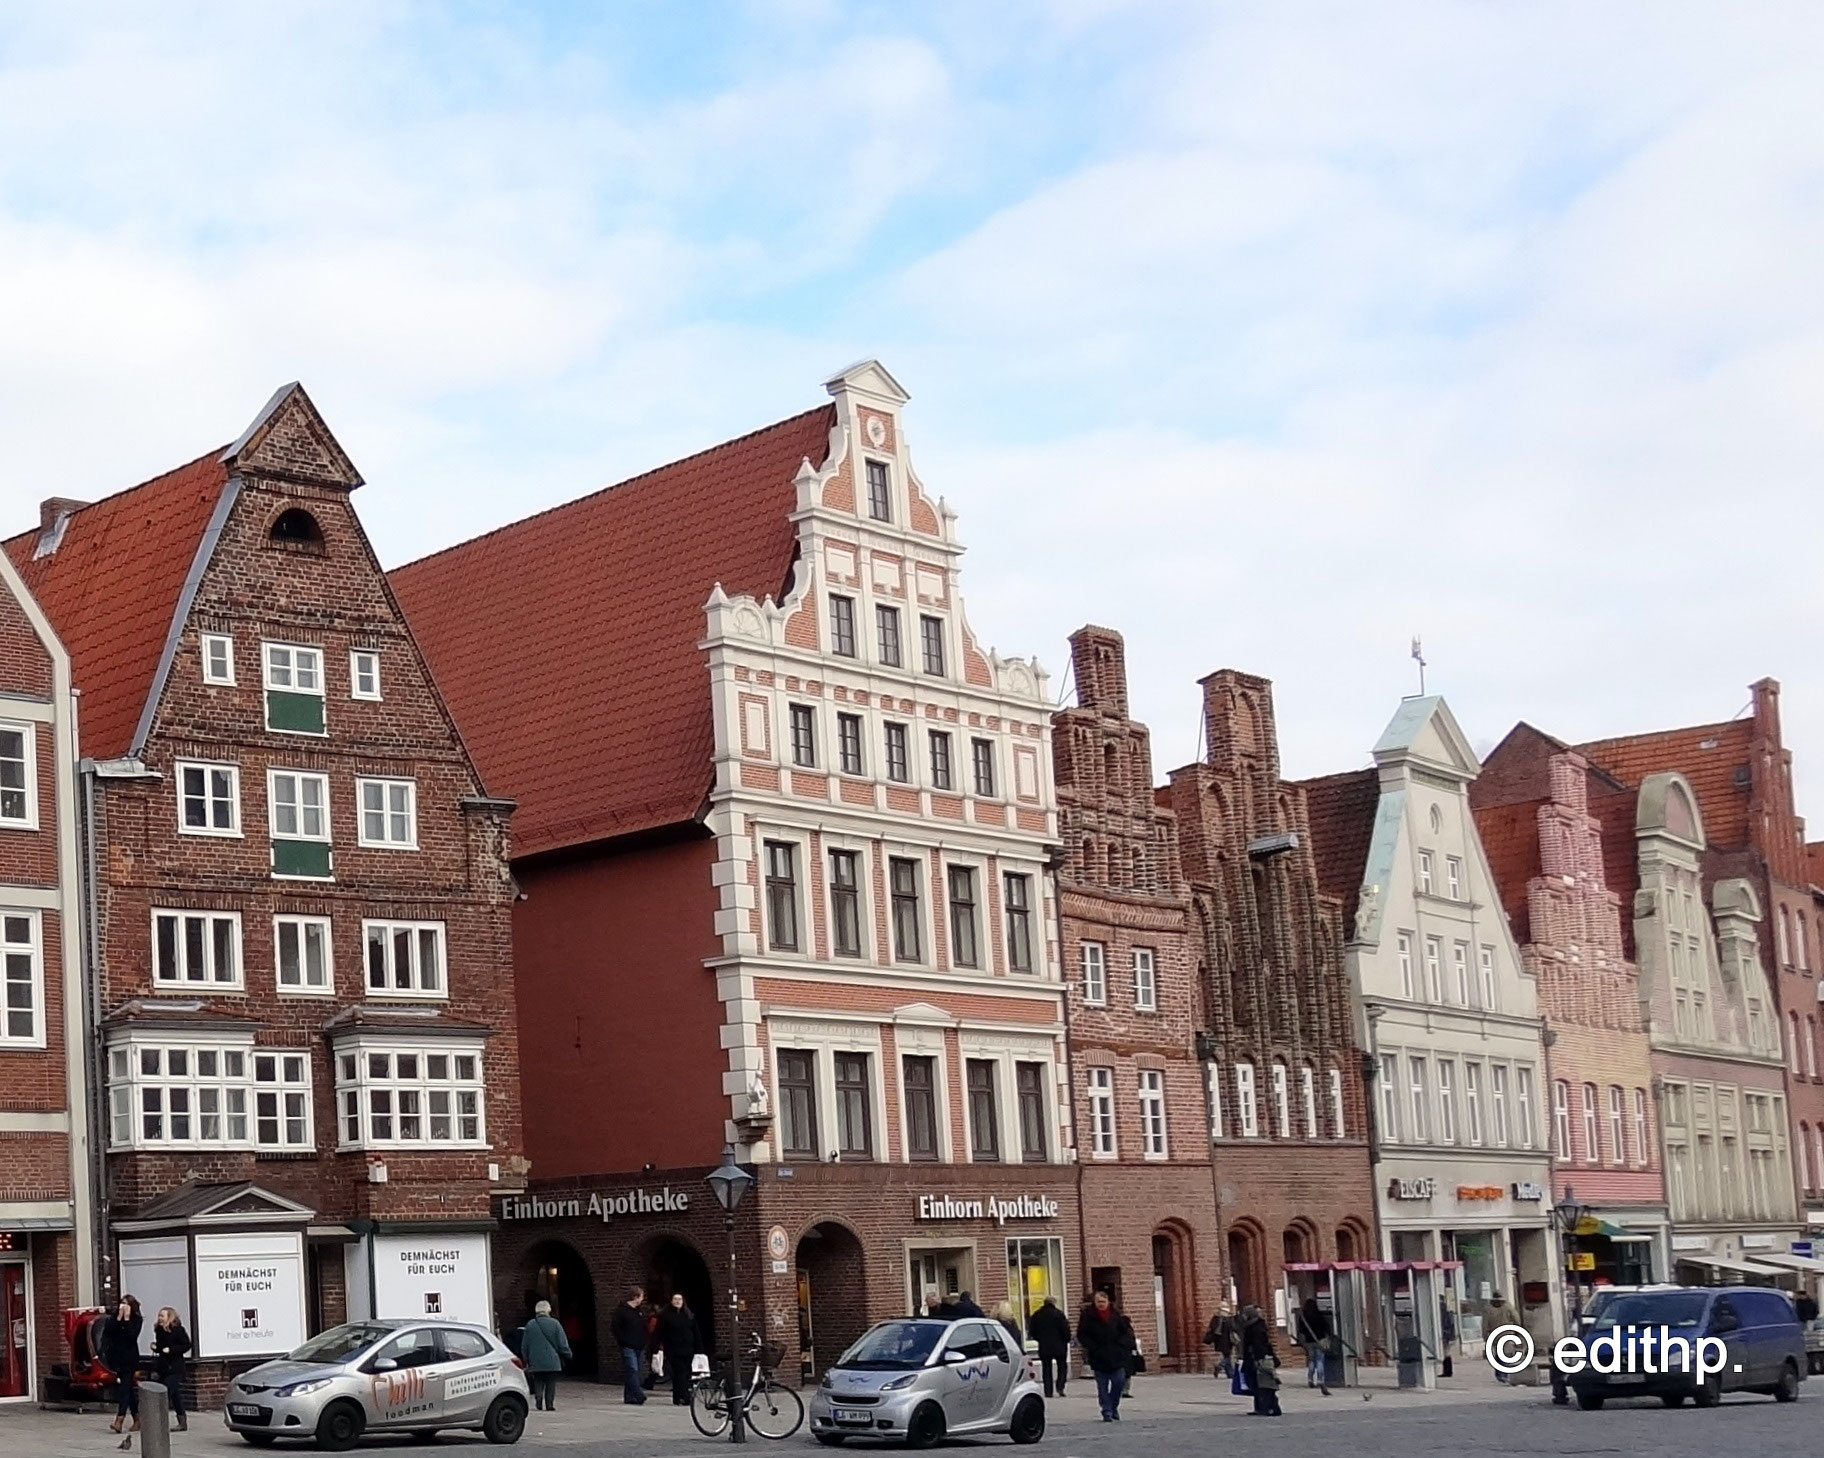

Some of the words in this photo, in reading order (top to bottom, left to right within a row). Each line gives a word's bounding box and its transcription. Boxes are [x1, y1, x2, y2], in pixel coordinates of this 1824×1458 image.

[502, 1195, 580, 1220] Einhorn
[587, 1187, 689, 1222] Apotheke
[919, 1194, 983, 1219] Einhorn
[987, 1194, 1058, 1225] Apotheke
[400, 1250, 460, 1261] DEMNÄCHST
[218, 1267, 277, 1280] DEMNÄCHST
[407, 1263, 425, 1275] FÜR
[429, 1264, 455, 1274] EUCH
[225, 1281, 242, 1292] FÜR
[246, 1281, 272, 1291] EUCH
[385, 1402, 434, 1420] foodman
